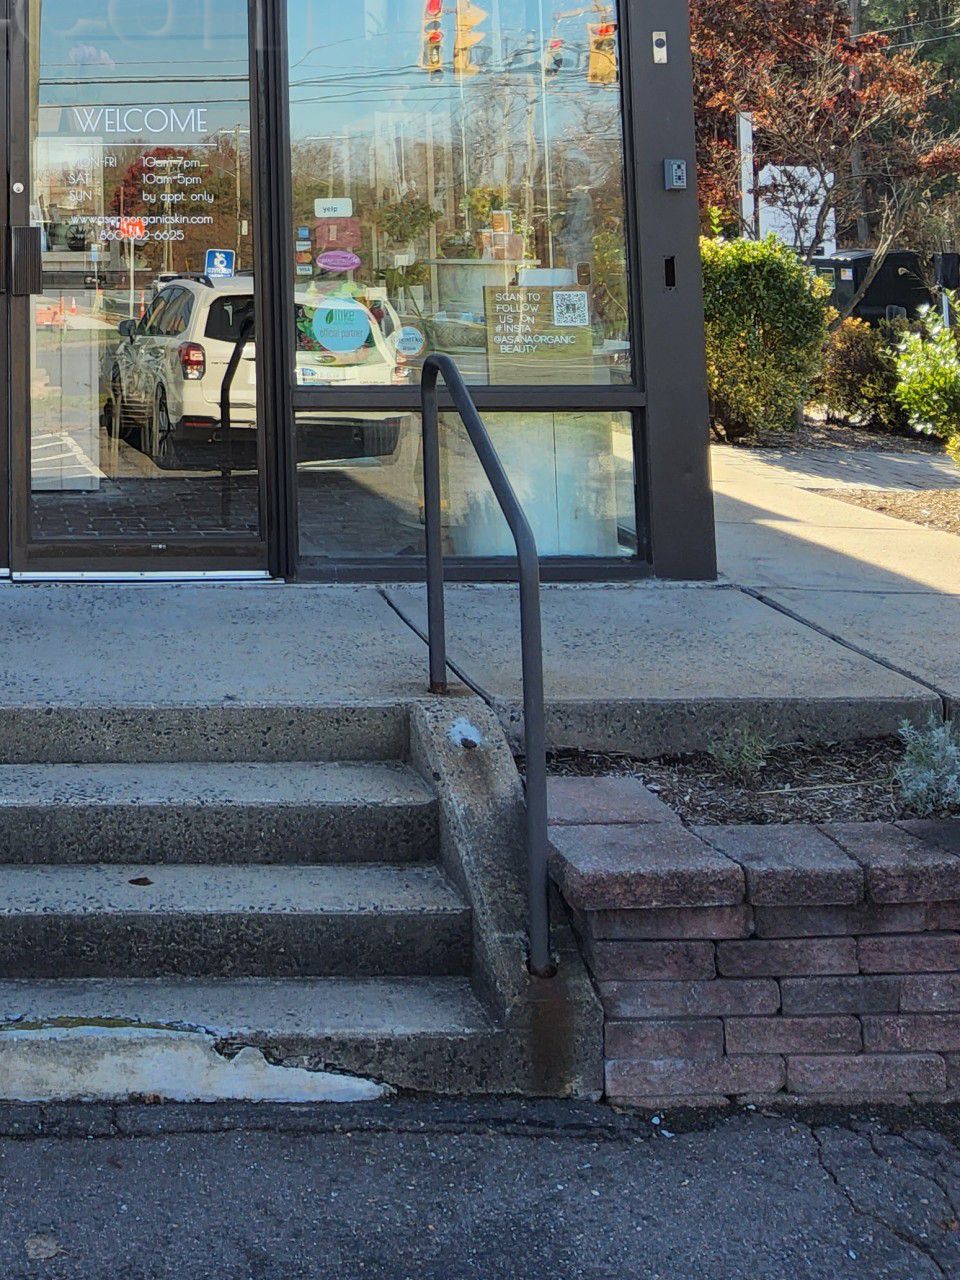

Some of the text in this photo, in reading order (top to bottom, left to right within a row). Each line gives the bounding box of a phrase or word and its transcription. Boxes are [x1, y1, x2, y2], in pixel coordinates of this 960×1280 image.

[74, 107, 208, 133] WELCOME
[142, 156, 201, 170] 10am-7pm
[68, 173, 202, 187] SAT 10am-5pm
[69, 191, 93, 202] SUN
[142, 191, 157, 204] by
[190, 190, 215, 204] only
[322, 205, 338, 214] yelp
[71, 213, 214, 227] www.asanaorganicskin.com
[495, 292, 541, 302] SCAN TO
[496, 303, 540, 313] FOLLOW
[499, 313, 535, 324] US ON
[341, 328, 364, 340] partner
[493, 334, 576, 344] @ASANAORGANIC
[499, 345, 538, 354] BEAUTY
